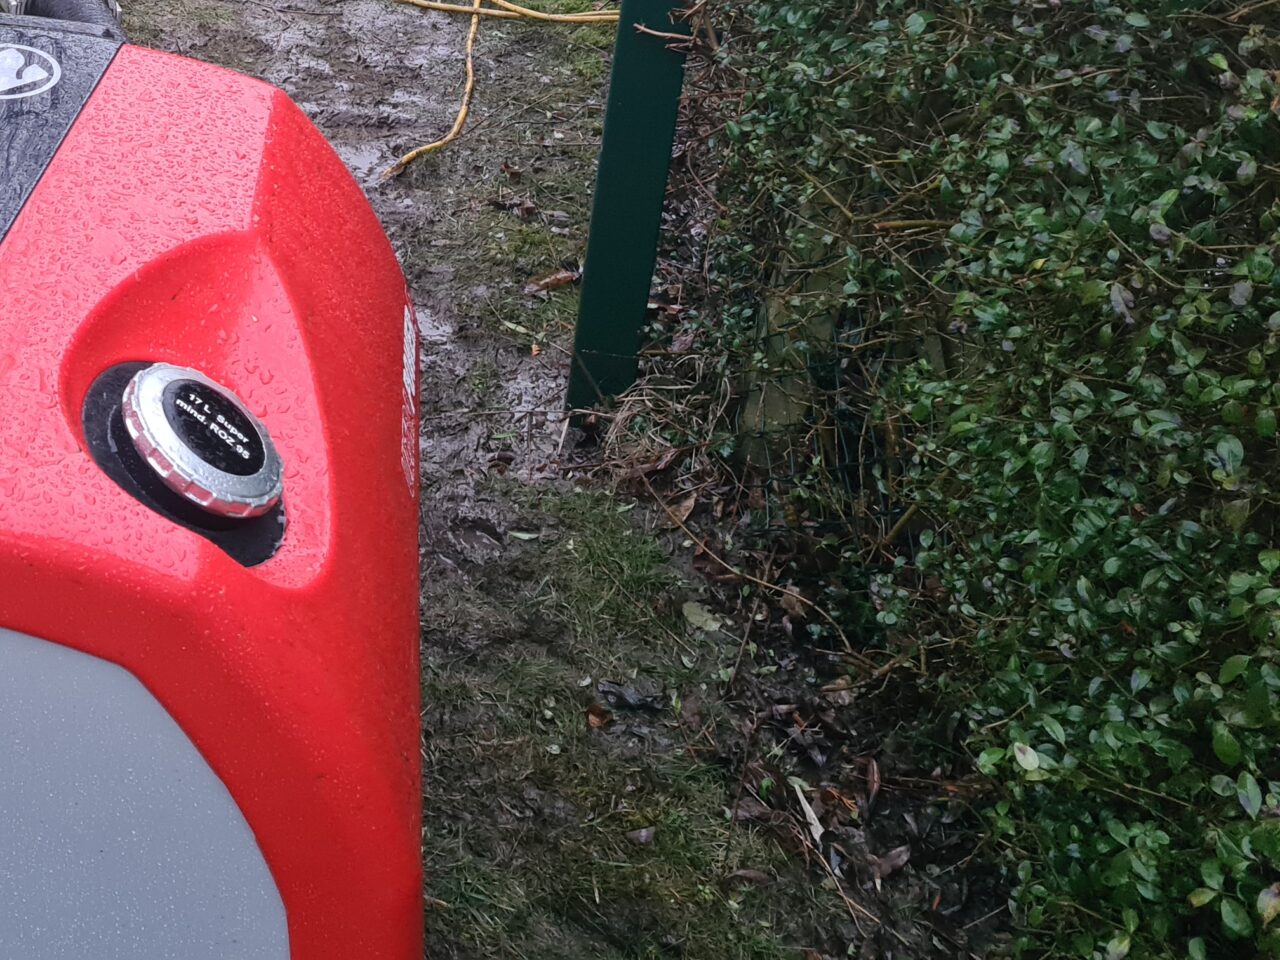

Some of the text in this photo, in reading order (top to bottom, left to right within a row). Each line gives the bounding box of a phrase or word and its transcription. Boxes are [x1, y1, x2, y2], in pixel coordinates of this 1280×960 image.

[175, 398, 250, 459] mind. ROZ 95
[189, 393, 250, 444] 17 L Super
